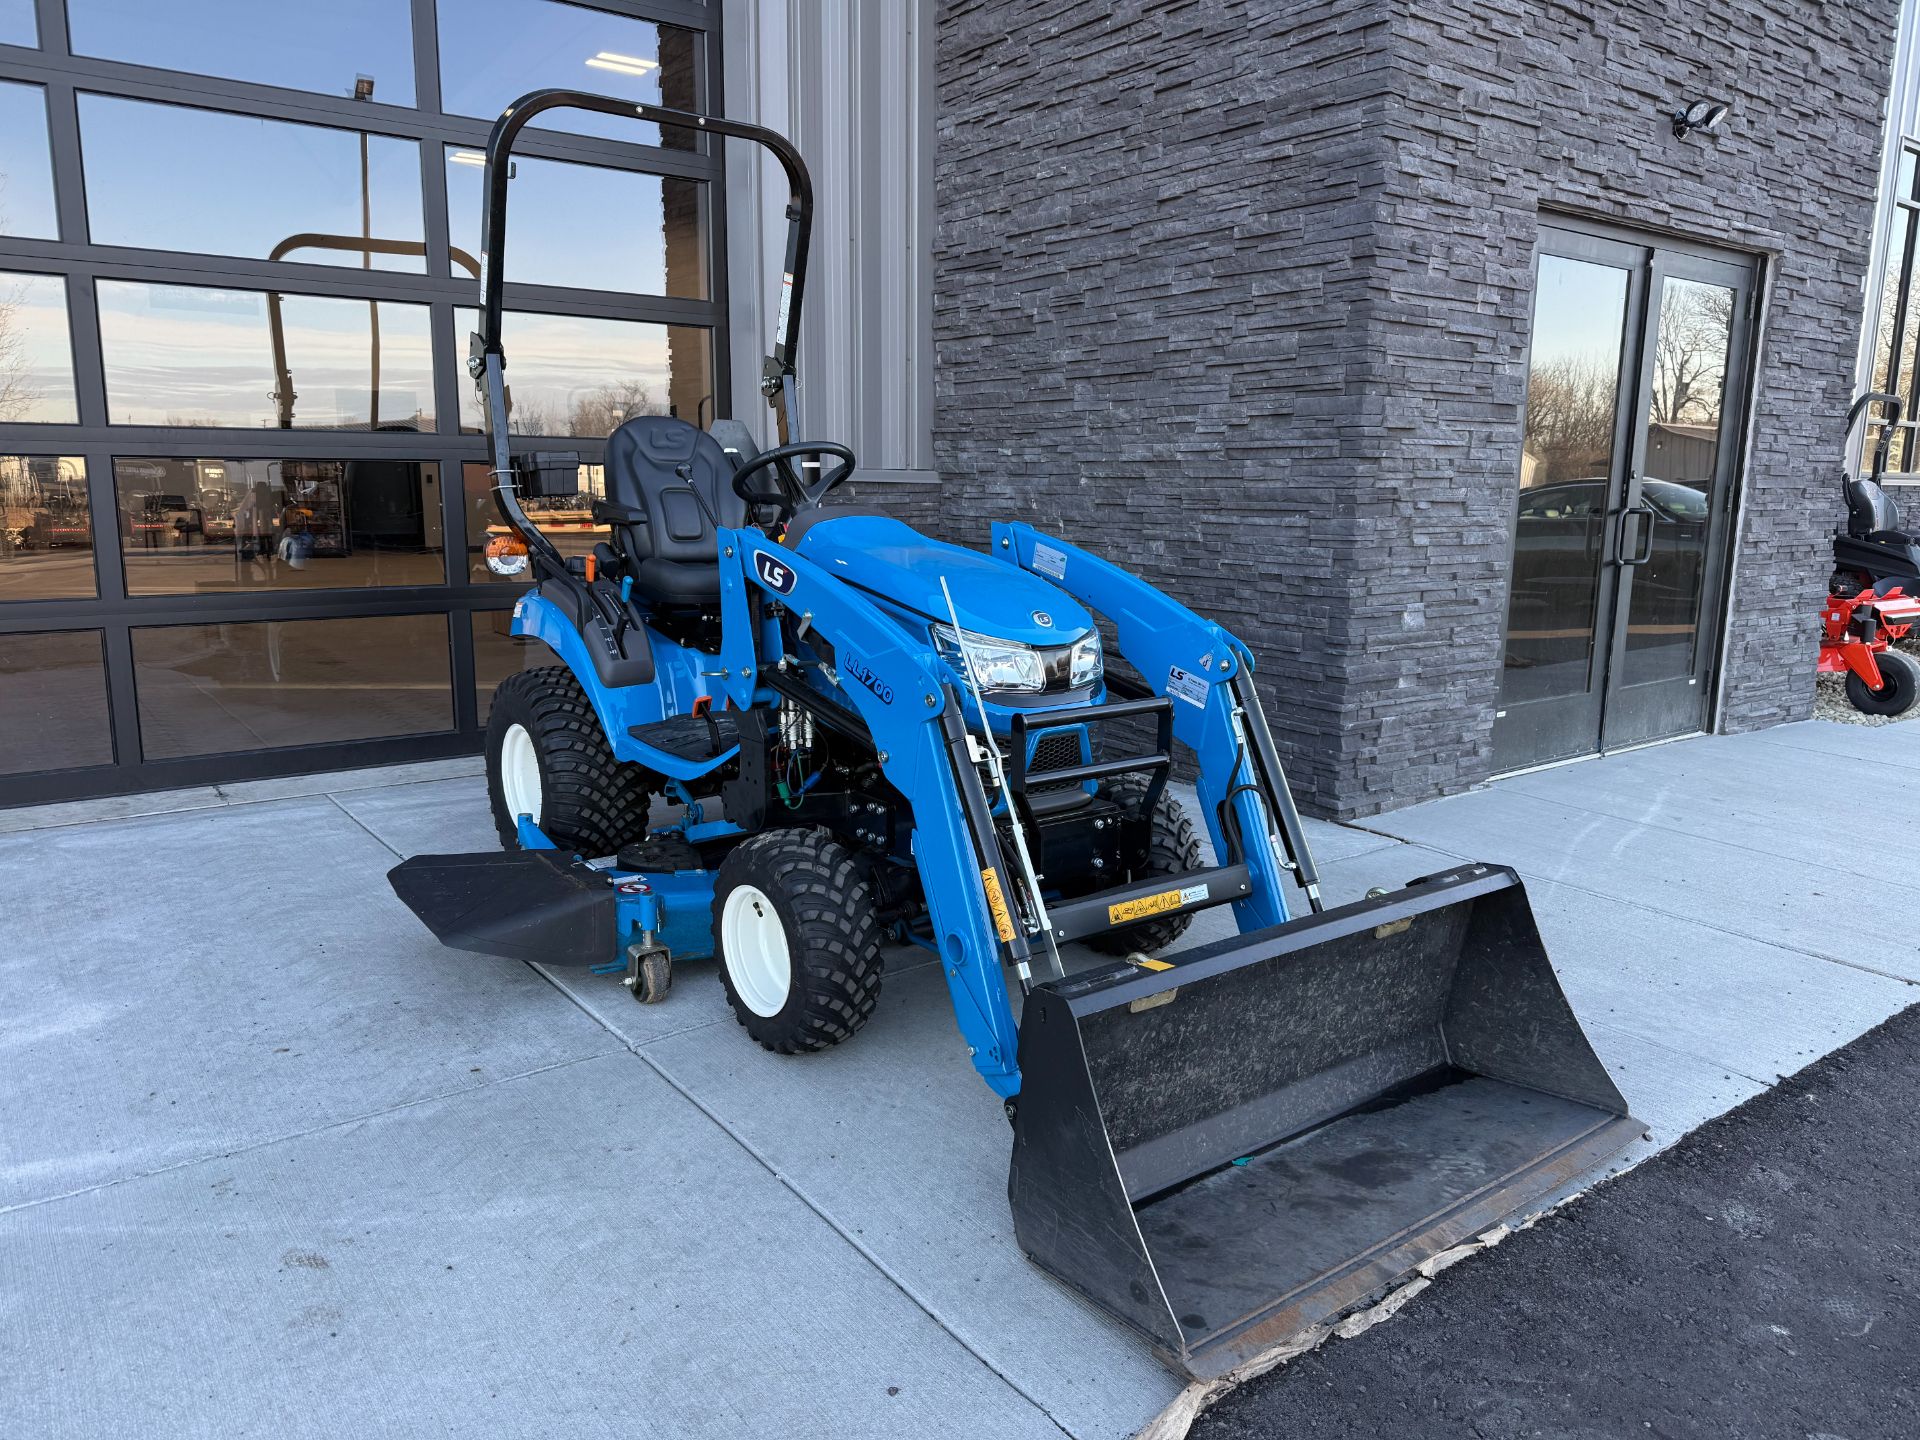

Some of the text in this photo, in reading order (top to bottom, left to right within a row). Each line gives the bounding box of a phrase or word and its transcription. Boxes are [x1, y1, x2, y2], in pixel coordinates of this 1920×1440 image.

[649, 428, 687, 449] LS
[763, 561, 784, 588] LS
[843, 651, 894, 705] LL1700
[1170, 667, 1184, 680] LS
